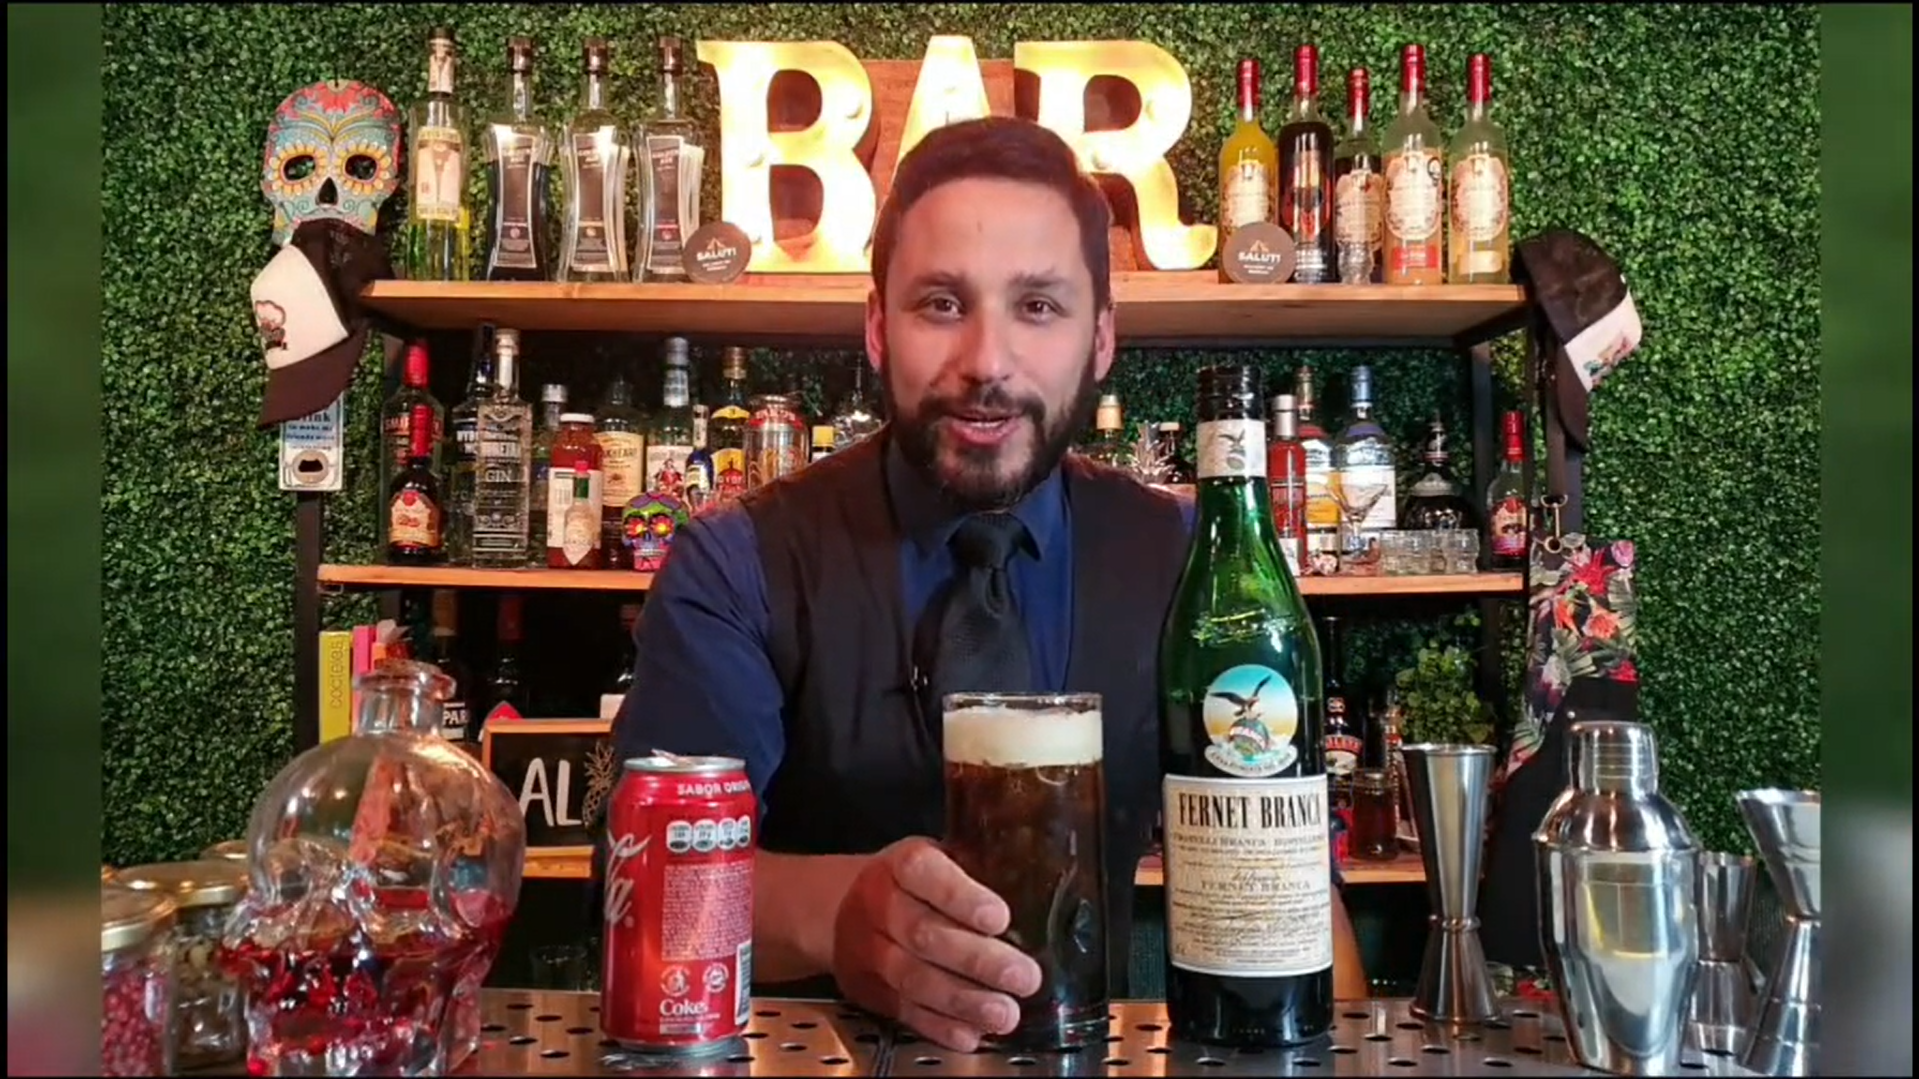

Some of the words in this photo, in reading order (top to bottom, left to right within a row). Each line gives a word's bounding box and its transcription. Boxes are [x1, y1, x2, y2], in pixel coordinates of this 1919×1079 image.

[485, 469, 512, 482] GIN
[677, 783, 722, 796] SABOR
[1178, 792, 1251, 830] FERNET
